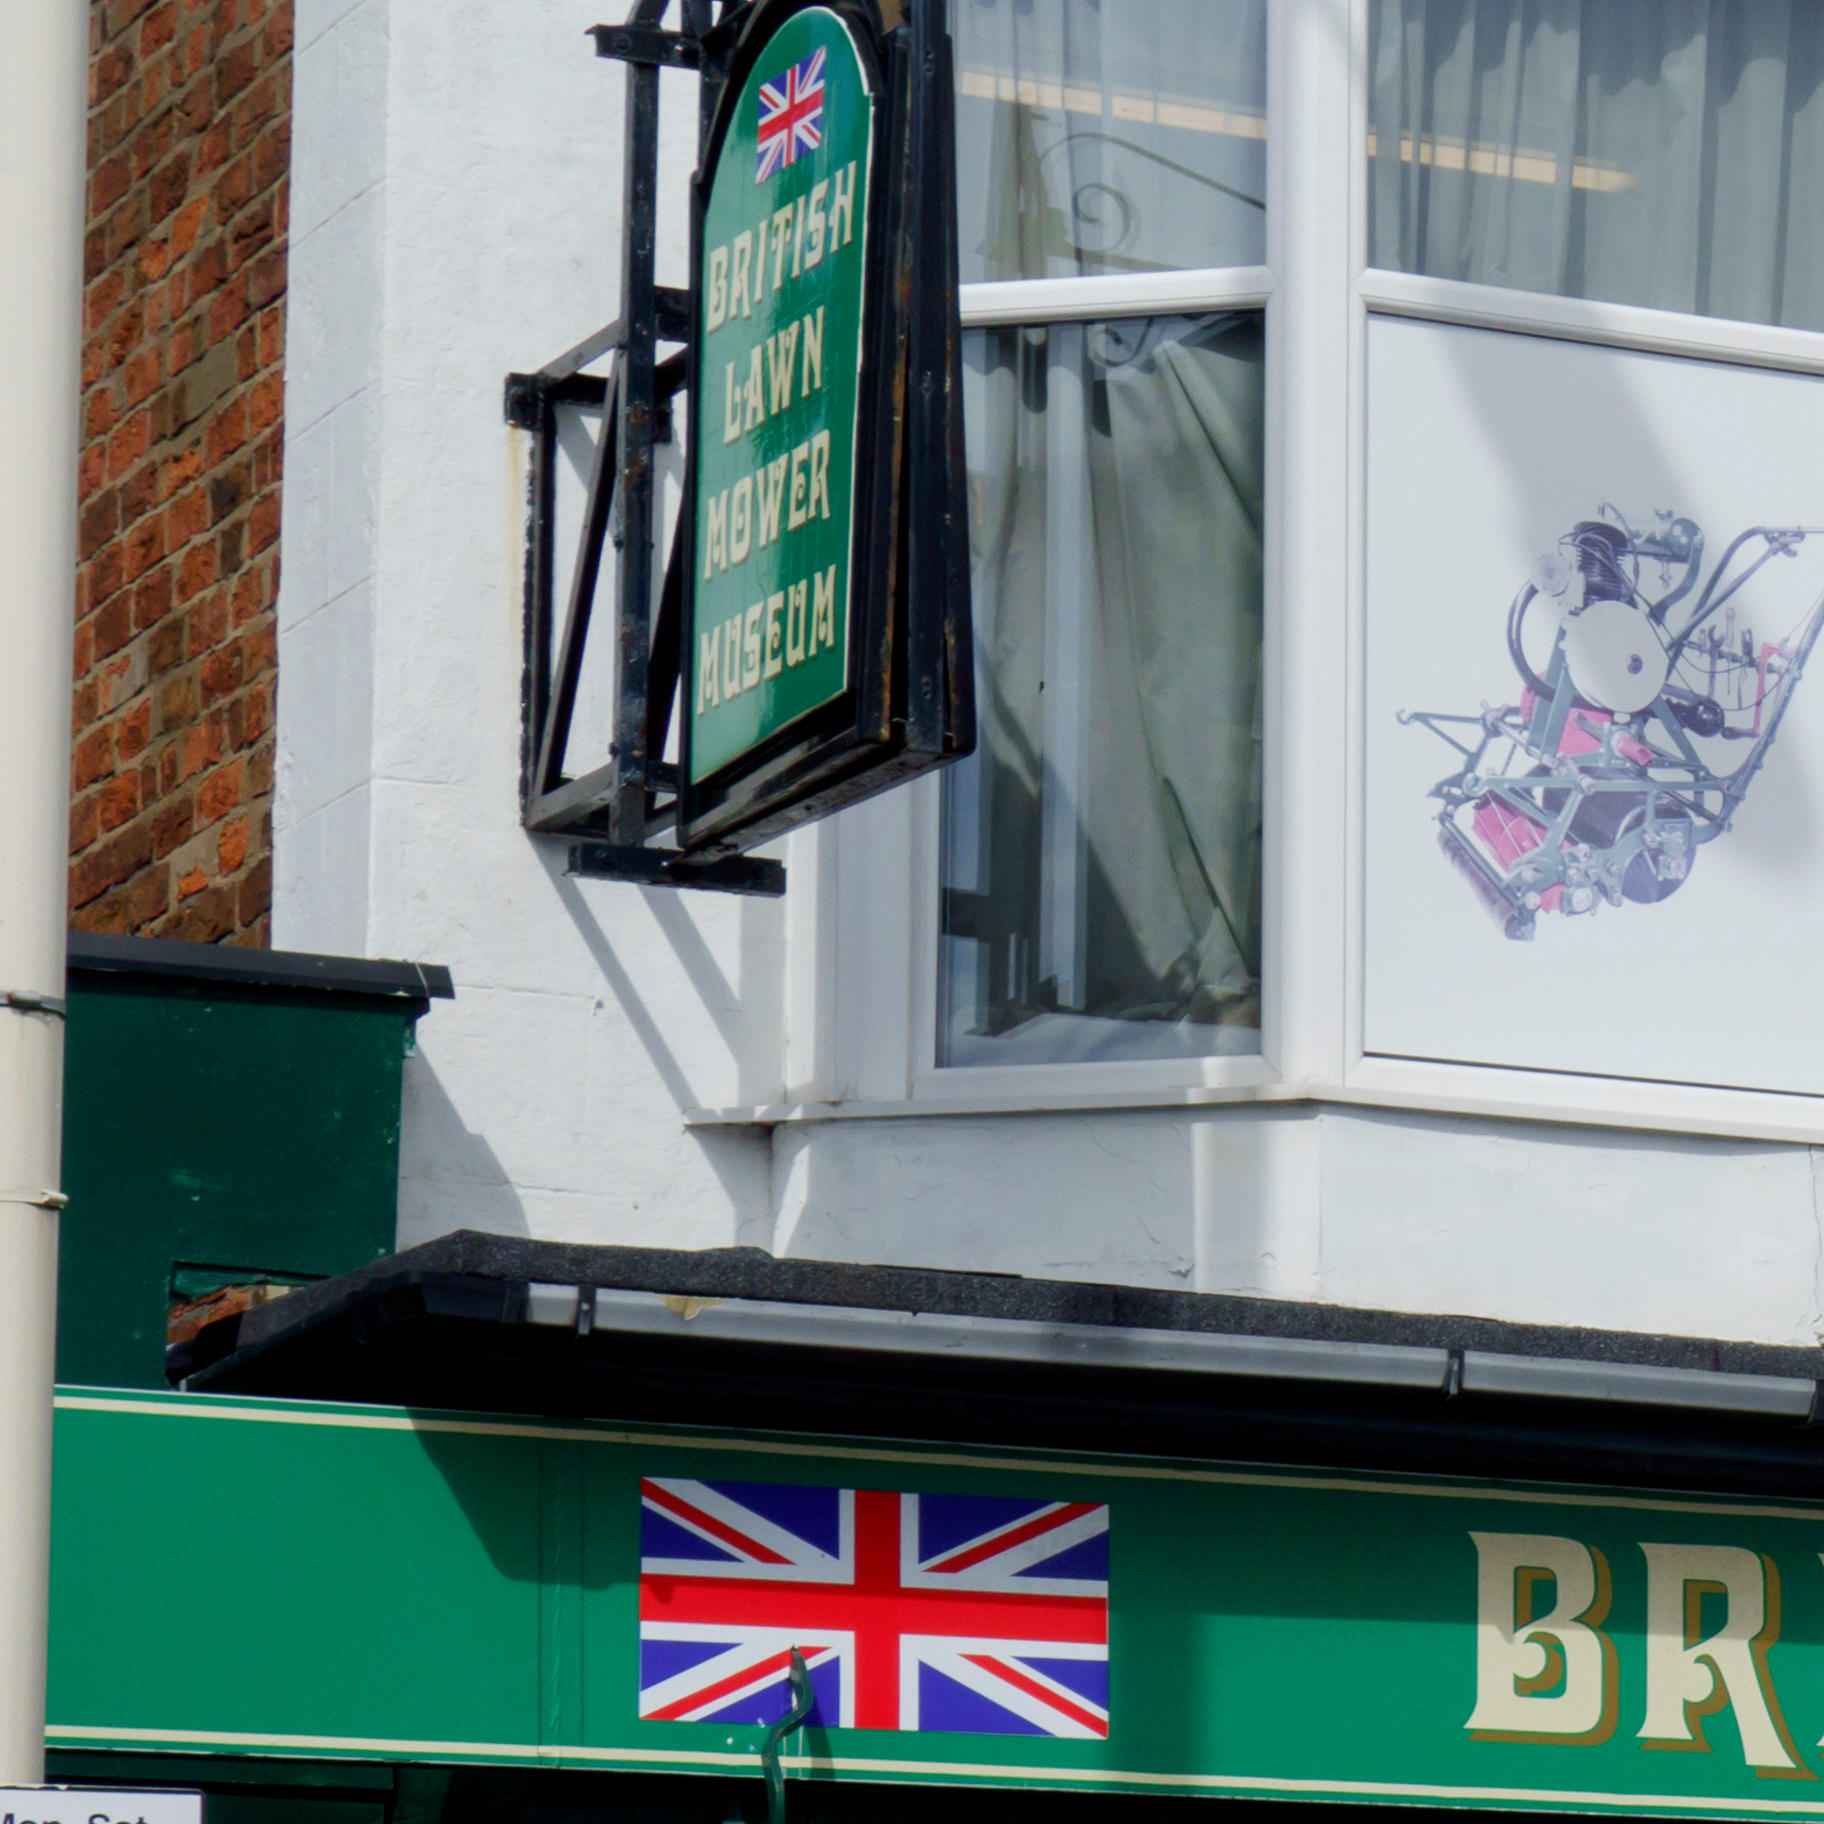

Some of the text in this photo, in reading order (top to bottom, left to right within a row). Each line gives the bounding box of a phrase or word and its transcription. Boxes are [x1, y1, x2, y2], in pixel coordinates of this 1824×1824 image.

[706, 161, 856, 335] BRITISH
[722, 305, 824, 444] LAWN
[704, 429, 830, 581] MOWER
[697, 564, 837, 716] MUSEUM
